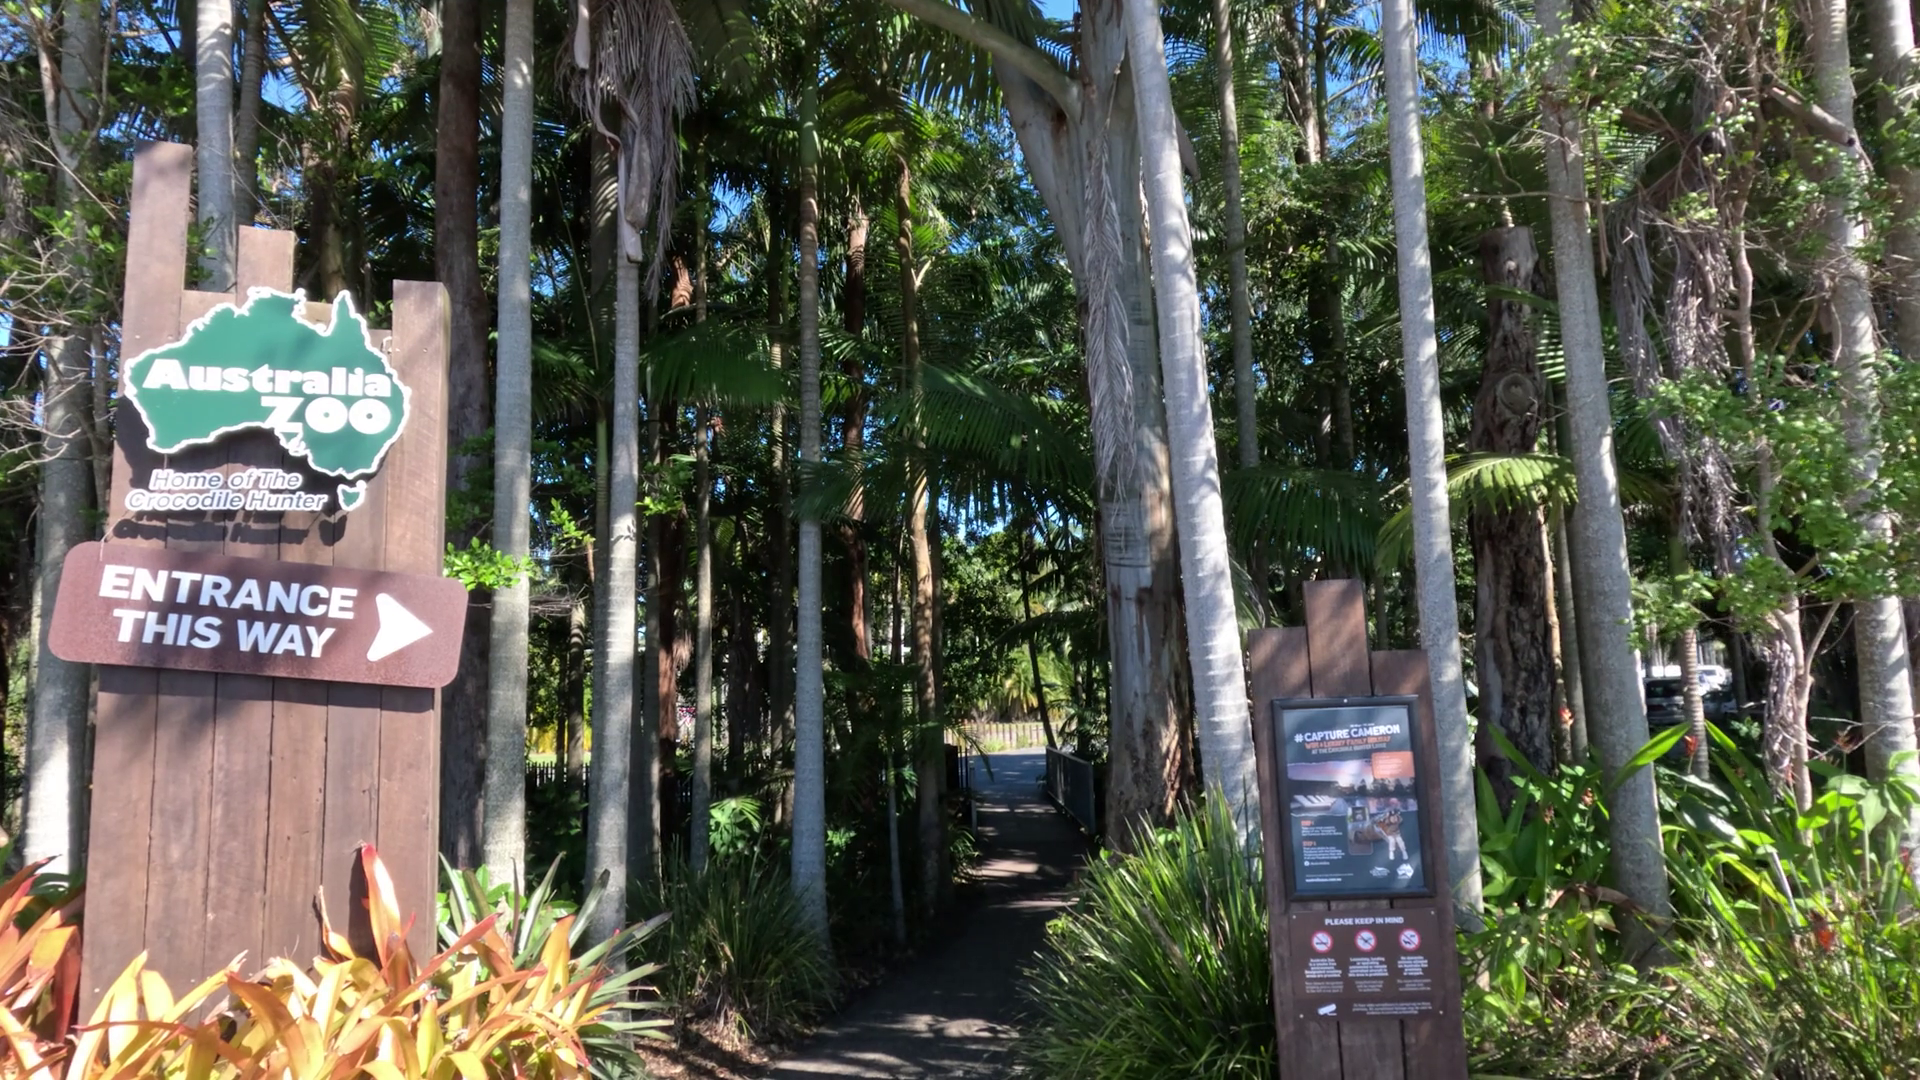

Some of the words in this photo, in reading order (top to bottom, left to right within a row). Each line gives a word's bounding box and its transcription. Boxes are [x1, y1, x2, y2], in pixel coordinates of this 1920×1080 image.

[142, 358, 391, 397] Australia
[151, 471, 222, 489] Home
[230, 471, 255, 489] of
[260, 471, 301, 489] The
[127, 490, 243, 510] Crocodile
[247, 492, 327, 510] Hunter
[98, 564, 358, 620] ENTRANCE
[112, 608, 223, 649] THIS
[236, 619, 336, 658] WAY
[1350, 724, 1400, 737] CAMERON
[1325, 918, 1353, 926] PLEASE
[1354, 917, 1374, 925] KEEP
[1384, 916, 1405, 924] MIND
